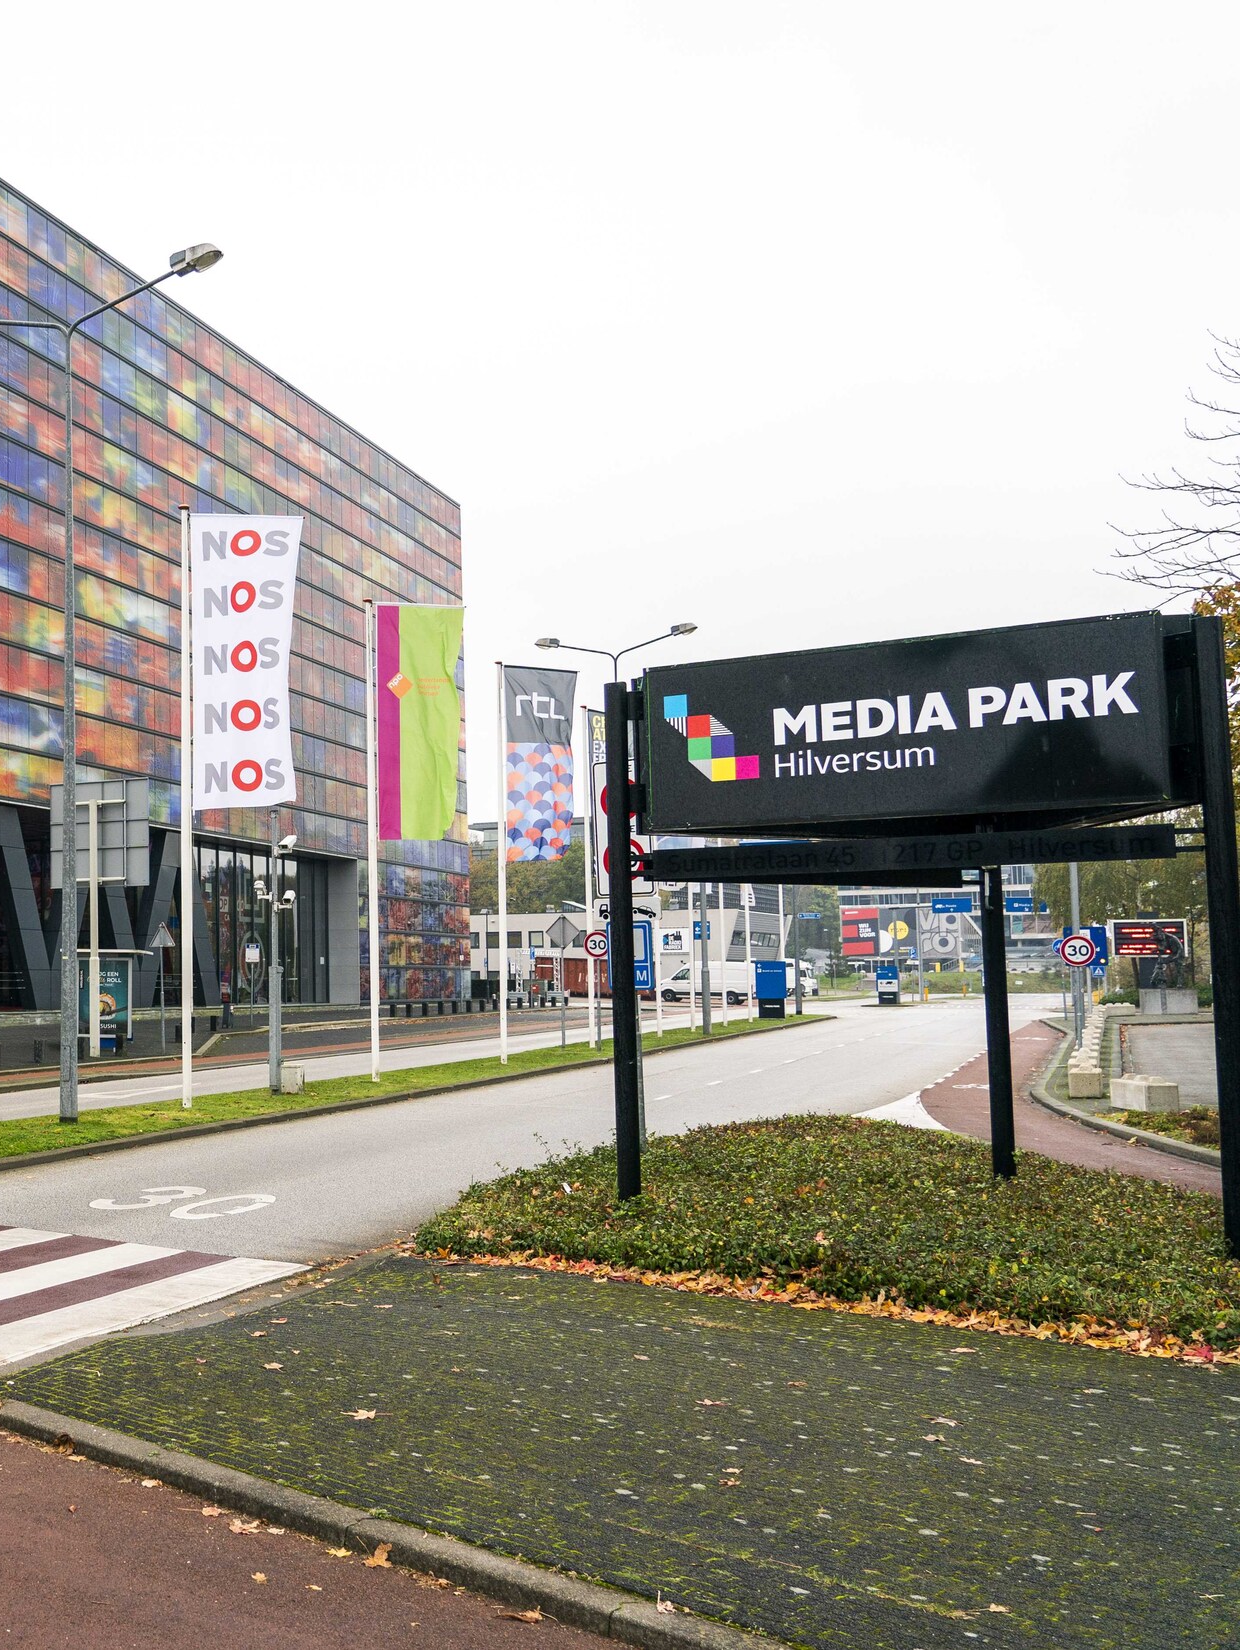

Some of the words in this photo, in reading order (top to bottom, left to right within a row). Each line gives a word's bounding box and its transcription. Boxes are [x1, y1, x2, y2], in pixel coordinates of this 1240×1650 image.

[202, 530, 290, 561] NOS
[203, 580, 285, 618] NOS
[203, 637, 280, 675] NOS
[389, 674, 403, 688] npo
[203, 697, 280, 734] NOS
[516, 692, 564, 720] rtl
[772, 691, 957, 746] MEDIA
[967, 671, 1139, 728] PARK
[204, 758, 285, 794] NOS
[774, 745, 936, 777] Hilversum
[825, 848, 855, 866] 45
[947, 840, 983, 861] GP
[1010, 836, 1155, 858] Hilversum
[589, 940, 607, 950] 30
[1067, 945, 1089, 956] 30
[89, 1185, 276, 1220] 30
